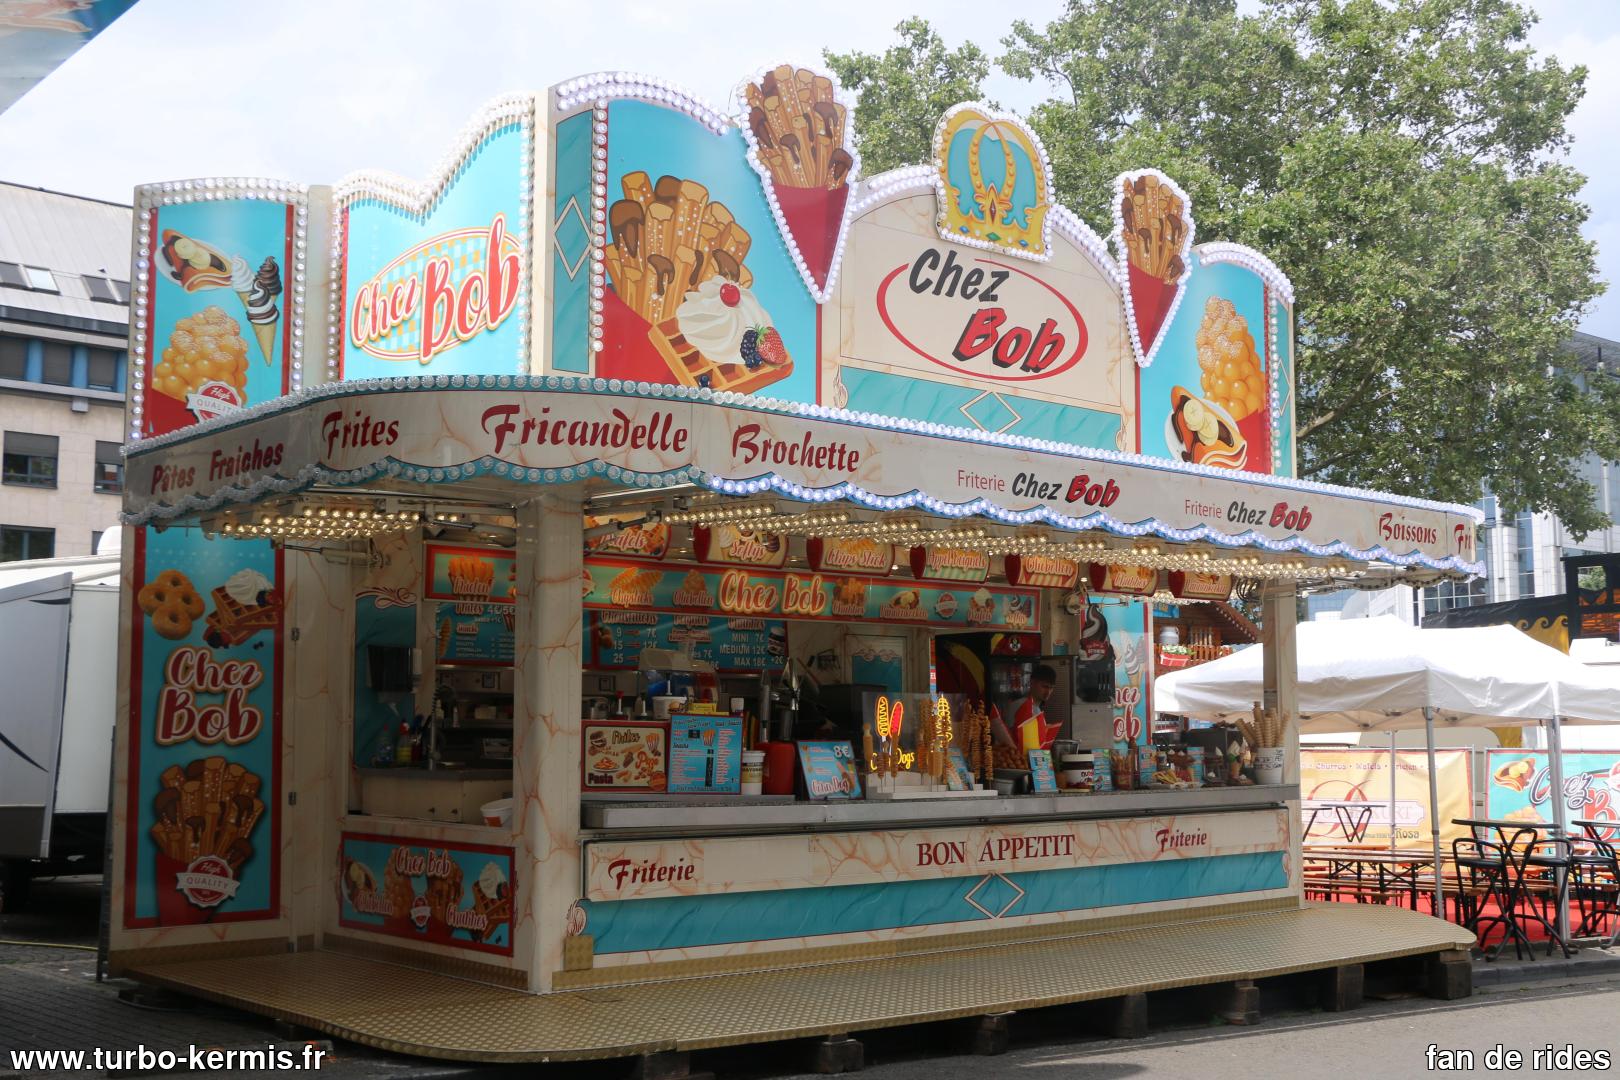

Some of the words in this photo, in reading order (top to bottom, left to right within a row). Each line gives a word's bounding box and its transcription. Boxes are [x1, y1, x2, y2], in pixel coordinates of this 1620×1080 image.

[353, 272, 418, 347] Chez
[419, 213, 521, 364] Bob
[908, 248, 1010, 302] Chez
[951, 307, 1066, 373] Bob
[210, 387, 232, 402] High
[321, 410, 399, 459] Frites
[481, 403, 689, 454] Fricandelle
[731, 422, 860, 473] Brochette
[151, 463, 195, 494] Pâtes
[208, 437, 284, 481] Fraiches
[957, 469, 1005, 492] Friterie
[1011, 472, 1063, 501] Chez
[1064, 474, 1121, 508] Bob
[1185, 499, 1222, 519] Friterie
[1227, 500, 1267, 526] Chez
[1268, 501, 1313, 532] Bob
[1378, 512, 1437, 545] Boissons
[720, 570, 778, 612] Chez
[782, 572, 826, 616] Bob
[731, 632, 749, 642] MINI
[167, 648, 263, 690] Chez
[157, 687, 262, 742] Bob
[1113, 705, 1141, 741] ob
[1530, 765, 1594, 810] Cez
[917, 838, 966, 867] BON
[979, 833, 1076, 863] APPETIT
[1156, 827, 1208, 853] Friterie
[186, 876, 230, 890] QUALITY
[394, 847, 426, 877] Chez
[426, 850, 451, 879] Bob
[608, 857, 695, 888] Friterie
